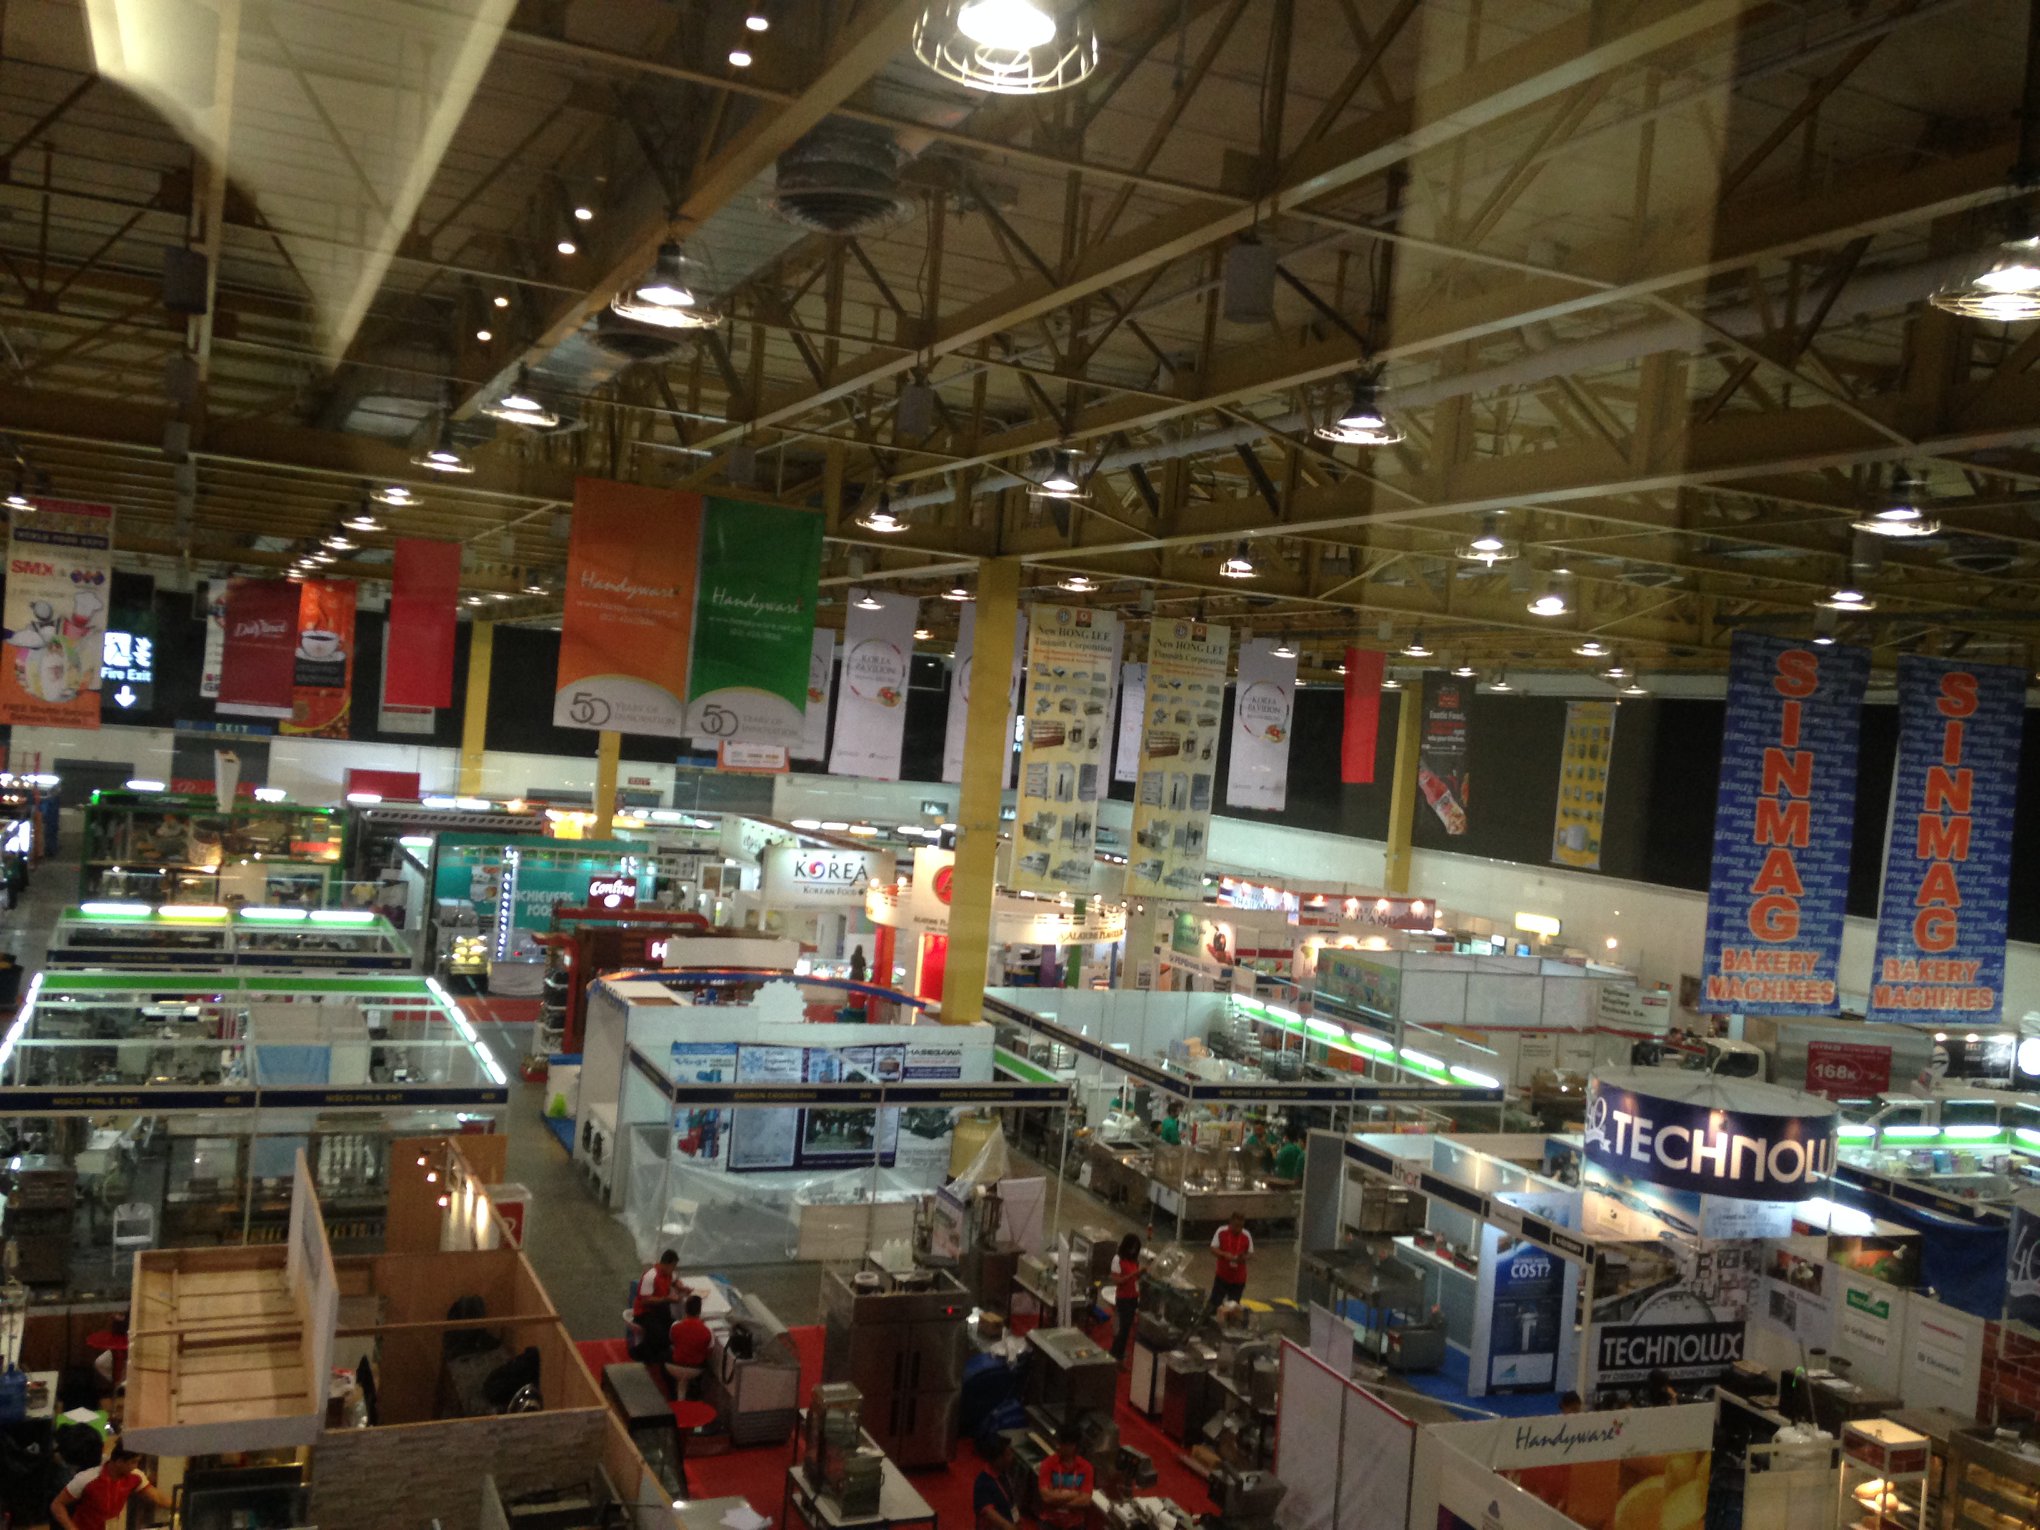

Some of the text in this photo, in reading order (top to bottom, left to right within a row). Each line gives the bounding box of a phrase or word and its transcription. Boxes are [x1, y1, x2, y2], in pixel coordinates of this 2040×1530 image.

[581, 570, 674, 600] Handyware
[712, 586, 799, 615] Handyware
[1059, 628, 1088, 638] HONG
[1091, 631, 1112, 641] LEE
[1177, 641, 1203, 652] HONG
[1206, 645, 1225, 655] LEE
[100, 666, 151, 682] Fire Exit
[216, 723, 249, 732] EXIT
[1748, 649, 1820, 942] SINMAG
[1913, 671, 1980, 952] SINMAG
[794, 859, 868, 886] KOREA
[1721, 947, 1820, 975] BAKERY
[1882, 958, 1983, 984] BAKERY
[1706, 975, 1836, 1005] MACHINES
[1872, 985, 1995, 1011] MACHINES
[1612, 1109, 1839, 1184] TECHNOLU
[1511, 1263, 1551, 1278] COST?
[1603, 1332, 1743, 1367] TECHNOLUX
[1516, 1424, 1617, 1455] Handyware
